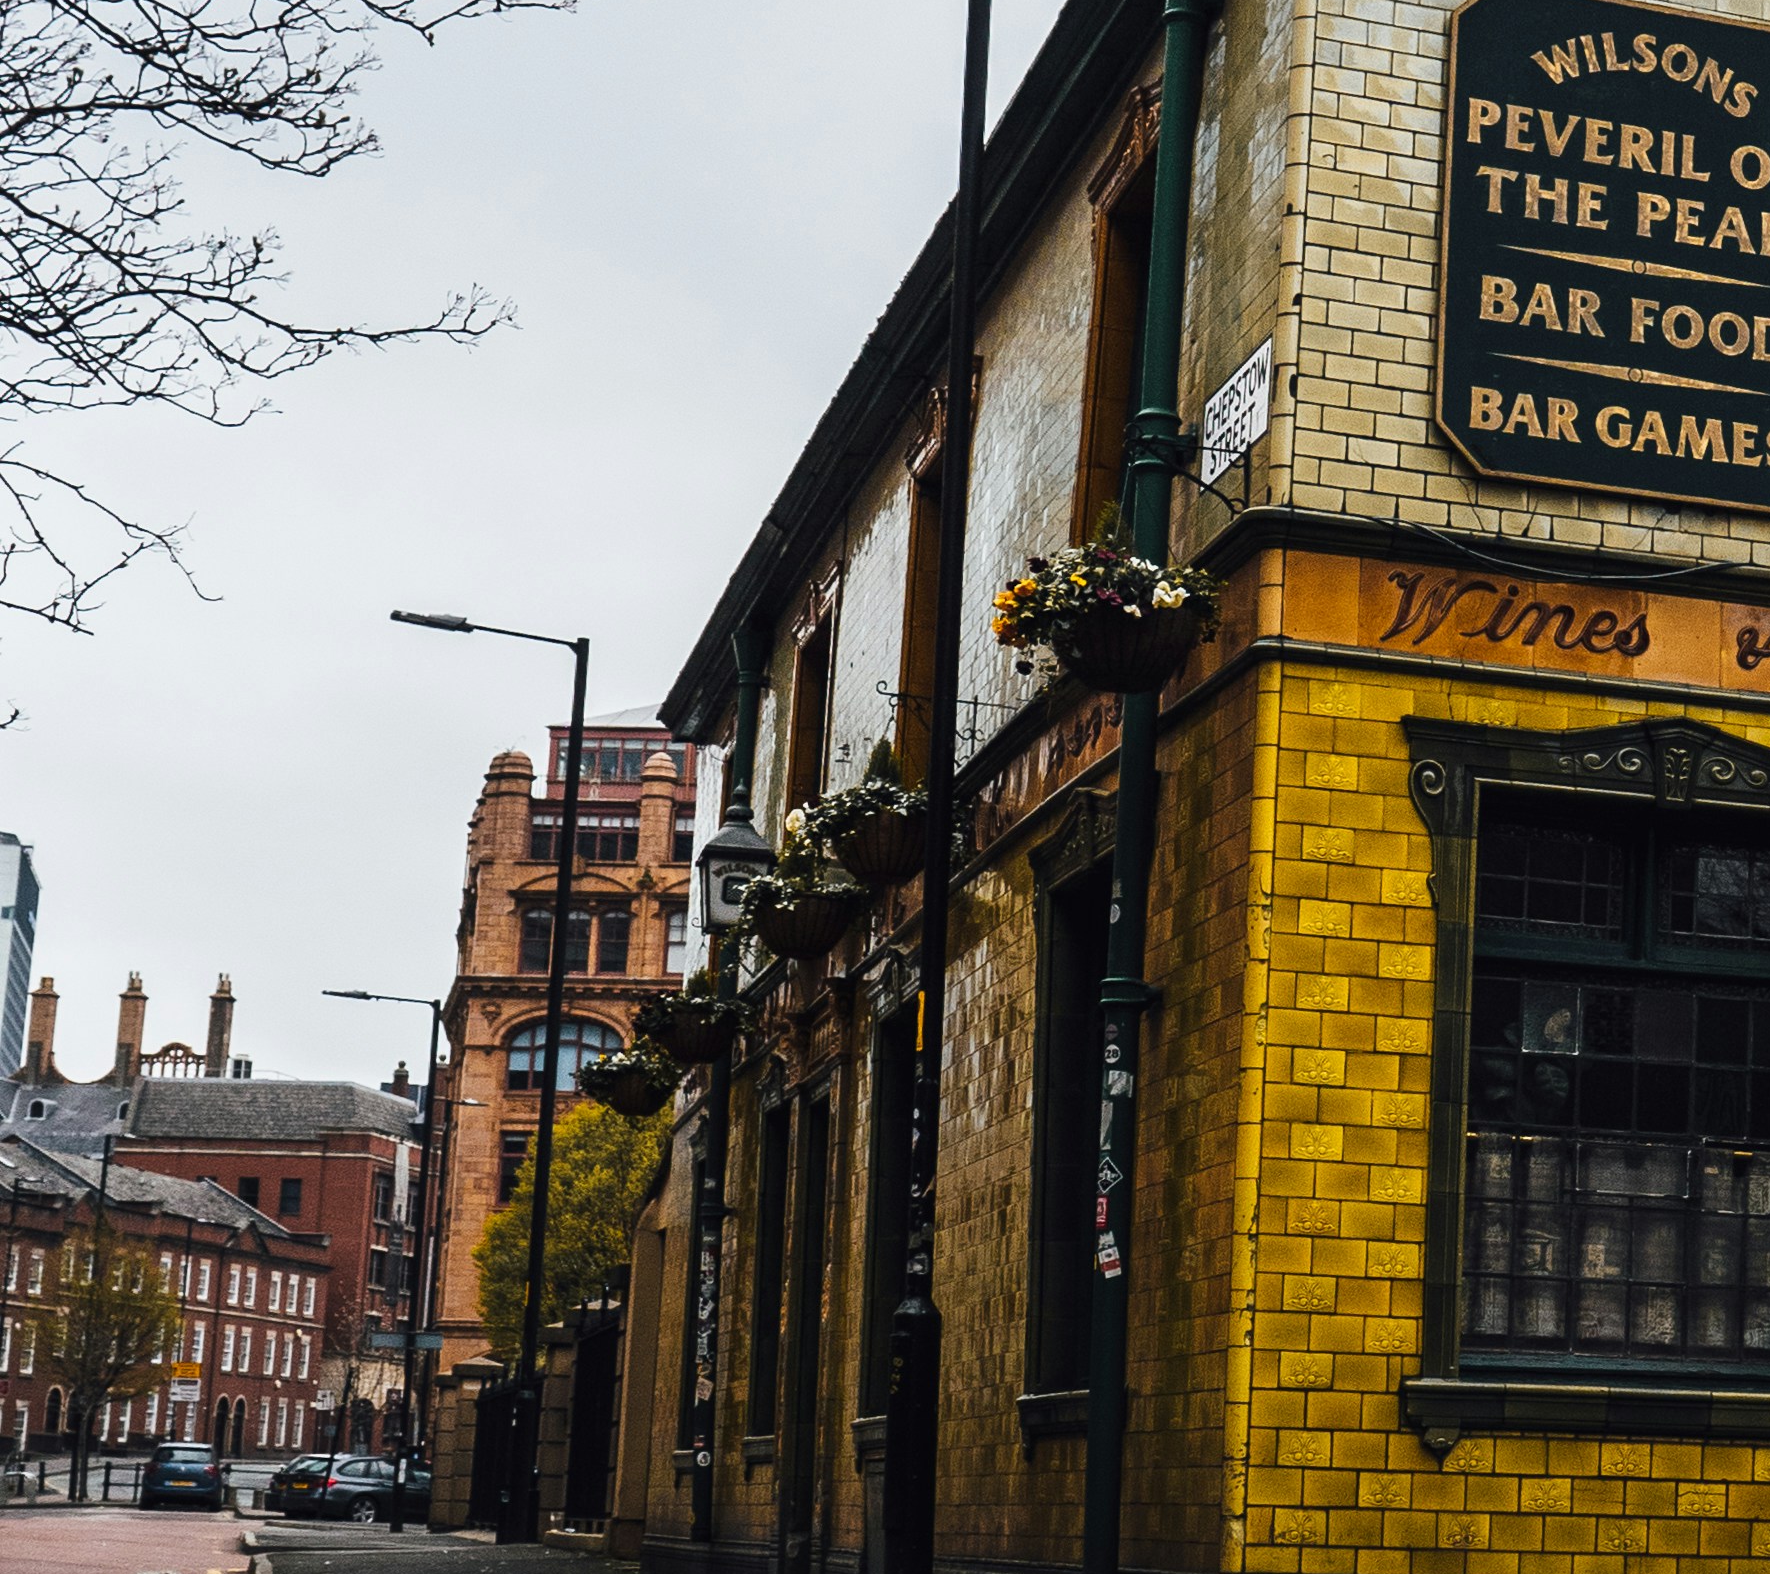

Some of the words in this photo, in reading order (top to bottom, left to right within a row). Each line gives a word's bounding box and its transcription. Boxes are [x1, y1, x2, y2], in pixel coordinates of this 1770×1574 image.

[1531, 32, 1759, 118] WILSONS
[1466, 98, 1711, 182] PEVERIL
[1476, 166, 1608, 231] THE
[1479, 275, 1605, 338] BAR
[1205, 346, 1270, 441] CHEPSTOW
[1469, 387, 1582, 444] BAR
[1209, 401, 1256, 475] STREET
[1379, 569, 1652, 658] Wines
[1105, 1049, 1119, 1059] 28
